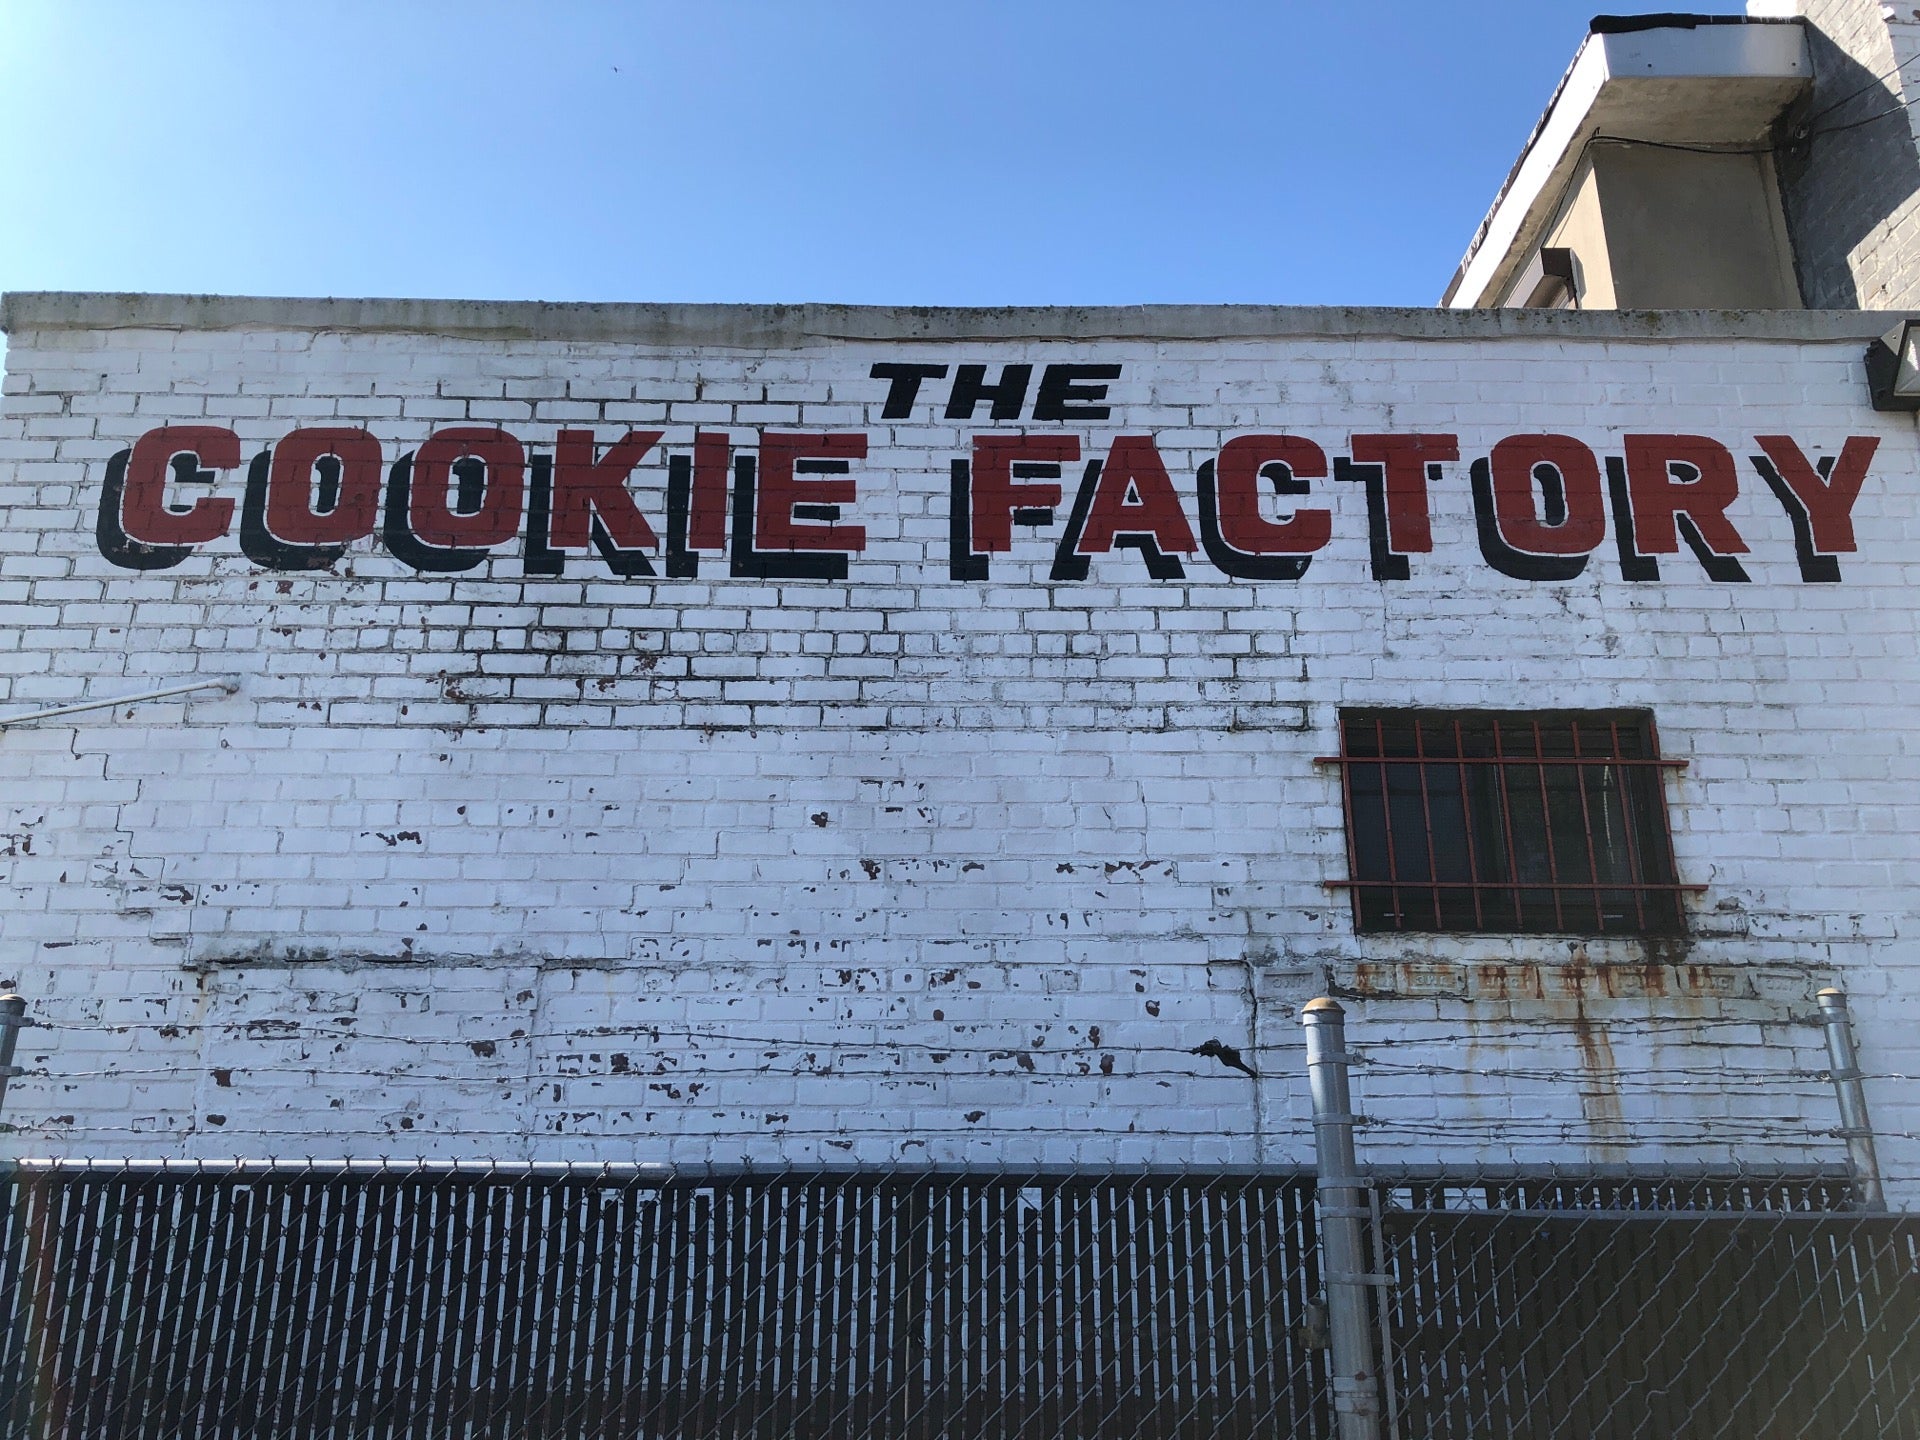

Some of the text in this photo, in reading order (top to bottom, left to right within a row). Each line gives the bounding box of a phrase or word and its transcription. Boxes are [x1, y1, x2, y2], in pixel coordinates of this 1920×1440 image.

[869, 362, 1122, 421] THE
[96, 425, 1880, 582] COOKIE FACTORY
